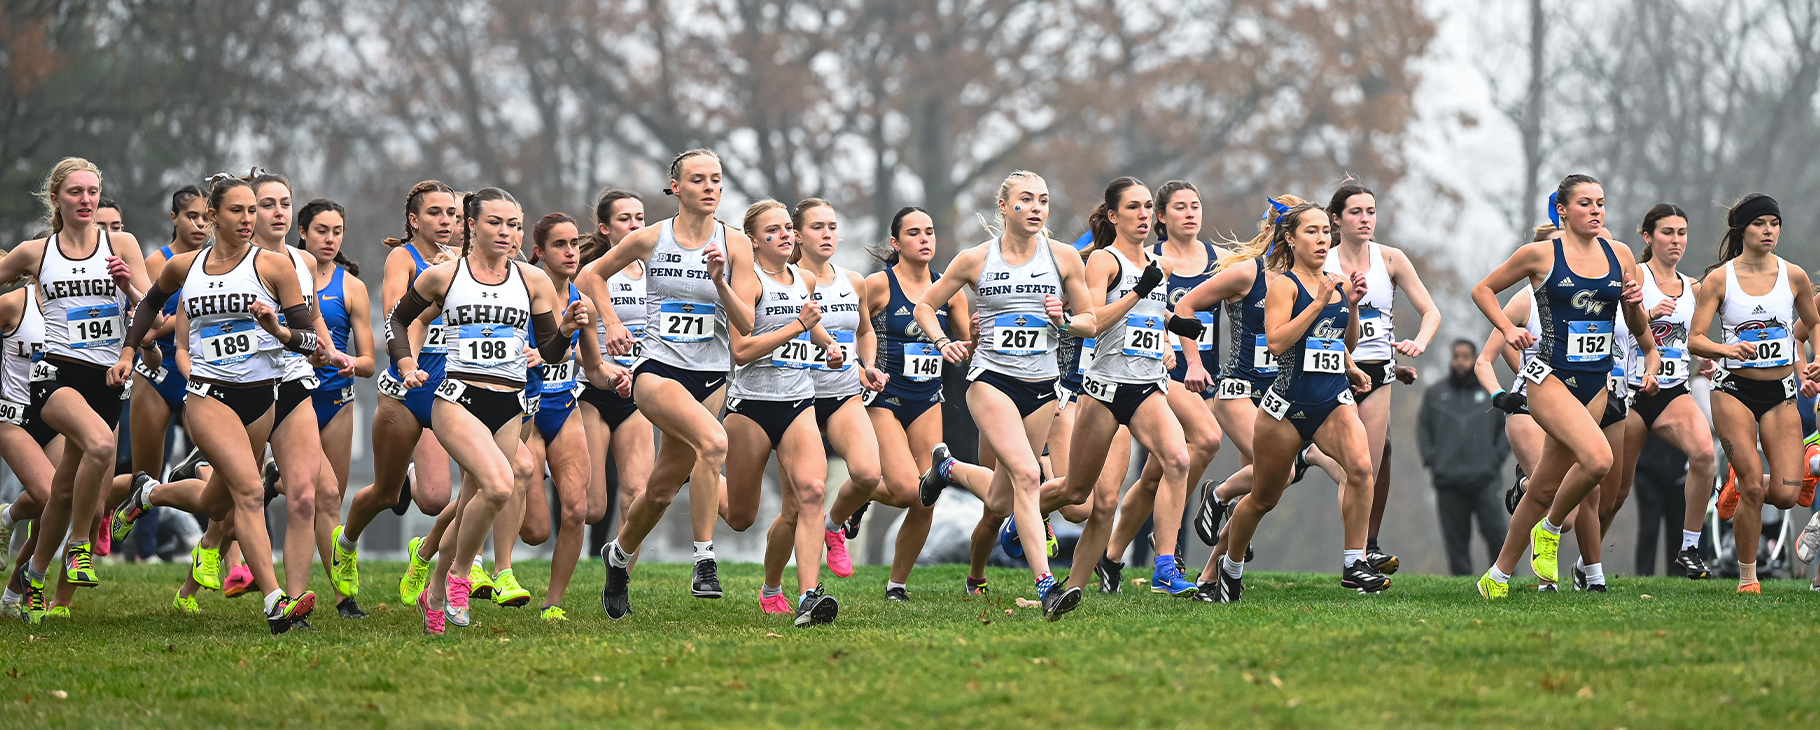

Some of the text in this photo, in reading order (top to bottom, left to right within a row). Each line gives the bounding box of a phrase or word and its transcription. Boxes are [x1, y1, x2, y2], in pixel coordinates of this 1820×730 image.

[650, 268, 725, 281] PENN STA
[43, 279, 118, 300] LEHIGH
[979, 284, 1056, 296] PENN STATE
[765, 306, 793, 316] PENN
[1571, 289, 1608, 315] GW
[443, 304, 530, 330] LEHIGH
[668, 315, 704, 335] 271
[77, 320, 113, 340] 194
[1001, 330, 1039, 348] 267
[211, 334, 250, 357] 189
[1131, 330, 1160, 350] 261
[1576, 335, 1606, 354] 152
[468, 340, 507, 360] 198
[780, 342, 808, 361] 270
[912, 358, 938, 375] 146
[1312, 352, 1340, 370] 153
[32, 364, 49, 379] 94
[542, 363, 568, 381] 278
[379, 375, 401, 396] 275
[1085, 376, 1108, 397] 261
[1222, 382, 1245, 396] 149
